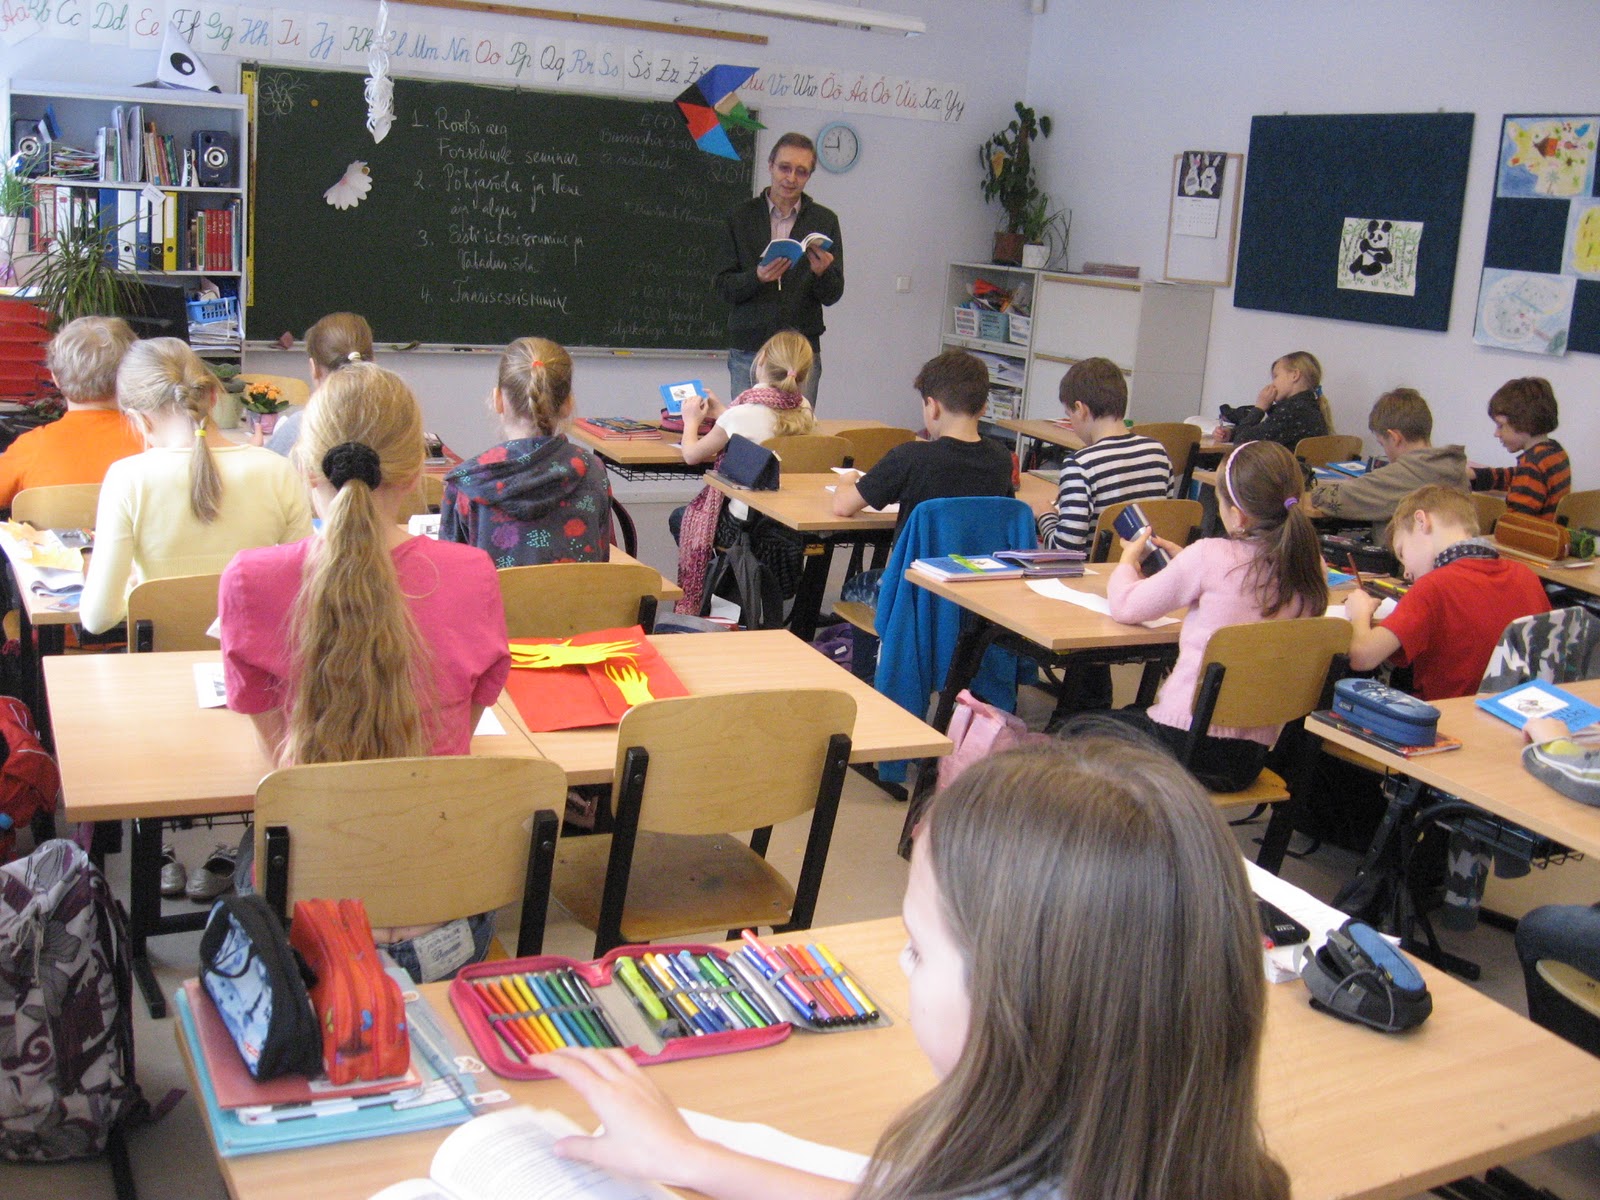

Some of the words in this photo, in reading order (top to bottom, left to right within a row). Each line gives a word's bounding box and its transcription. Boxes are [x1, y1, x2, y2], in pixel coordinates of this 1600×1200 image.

[57, 0, 82, 27] Cc
[92, 2, 129, 31] Dd
[135, 8, 160, 36] Ee
[172, 8, 201, 44] Ff
[204, 12, 235, 52] Gg
[239, 18, 269, 47] Hh
[277, 18, 302, 47] Ii
[309, 22, 336, 60] Jj
[343, 26, 373, 53] Kk
[408, 34, 440, 61] Mm
[441, 36, 471, 64] Nn
[475, 40, 502, 65] Oo
[505, 41, 532, 78] Pp
[539, 45, 566, 81] Qq
[566, 48, 596, 75] Rr
[598, 52, 619, 77] Ss
[627, 49, 652, 80] Šš
[655, 58, 680, 84] Zz
[683, 56, 709, 85] Ž
[767, 73, 791, 97] Vv
[793, 73, 819, 97] Ww
[918, 86, 943, 110] Xx
[944, 89, 967, 122] Yy
